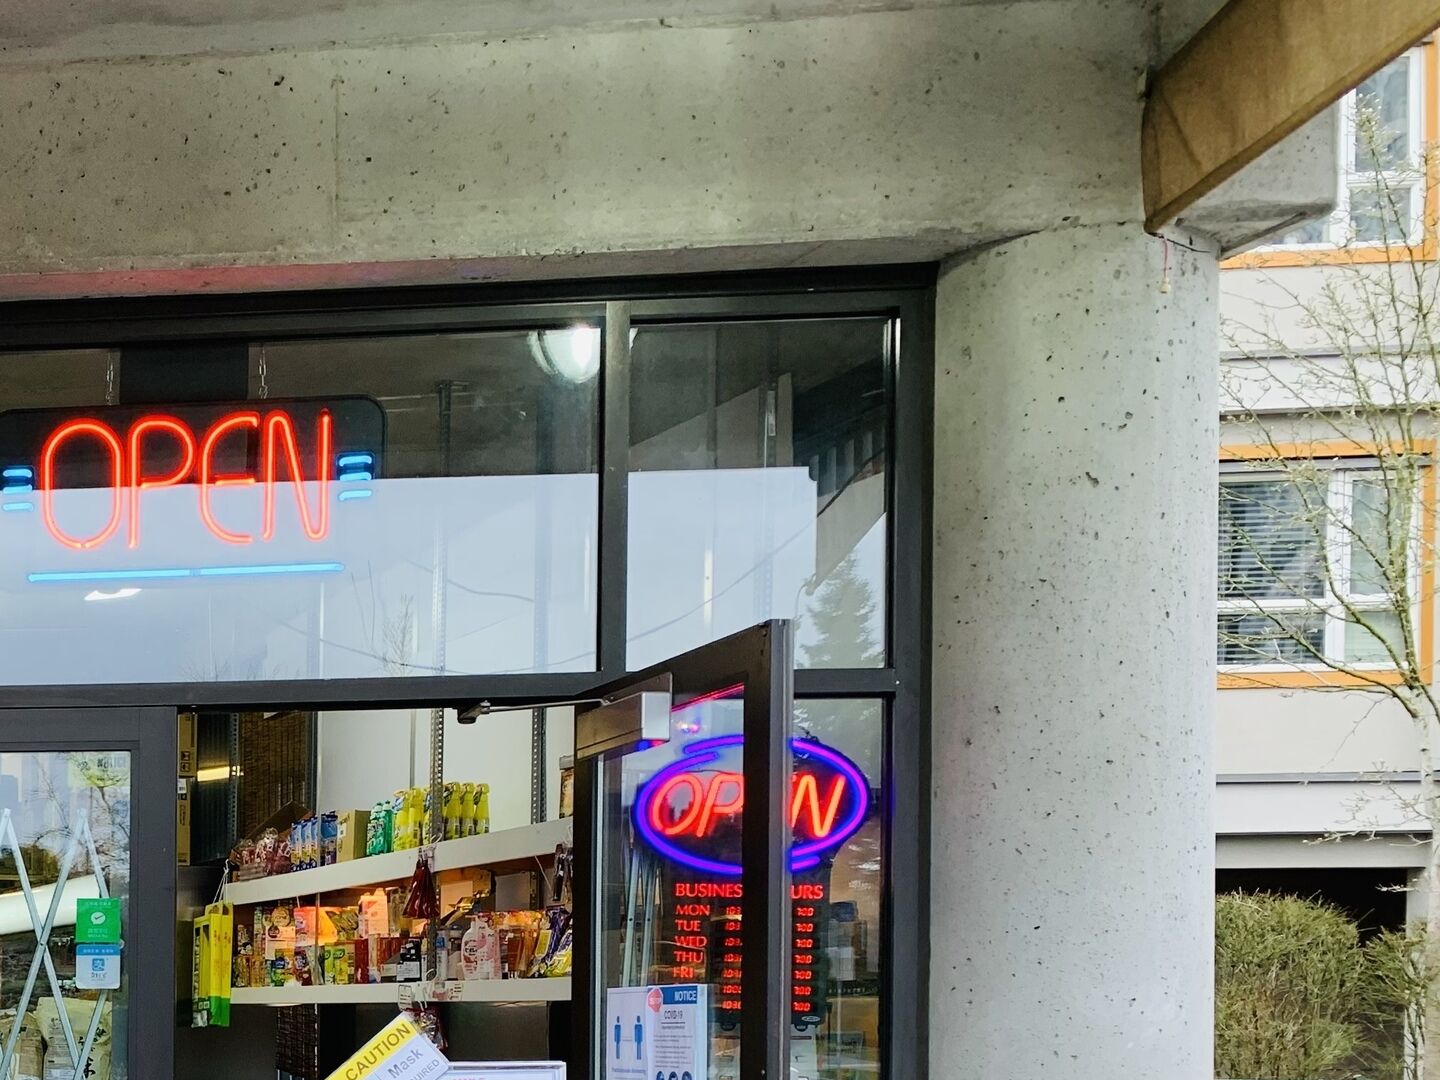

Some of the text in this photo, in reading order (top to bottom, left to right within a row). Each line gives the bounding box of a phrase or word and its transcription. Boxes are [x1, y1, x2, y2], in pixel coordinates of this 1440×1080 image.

[40, 408, 332, 550] OPEN
[649, 772, 847, 838] OPN
[675, 883, 743, 898] BUSINES
[675, 904, 710, 916] MON
[674, 920, 701, 931] TUE
[674, 936, 708, 947] WED
[673, 951, 704, 963] THU
[672, 968, 694, 979] FRI
[674, 991, 697, 1002] NOTICE
[387, 1049, 424, 1079] Mask
